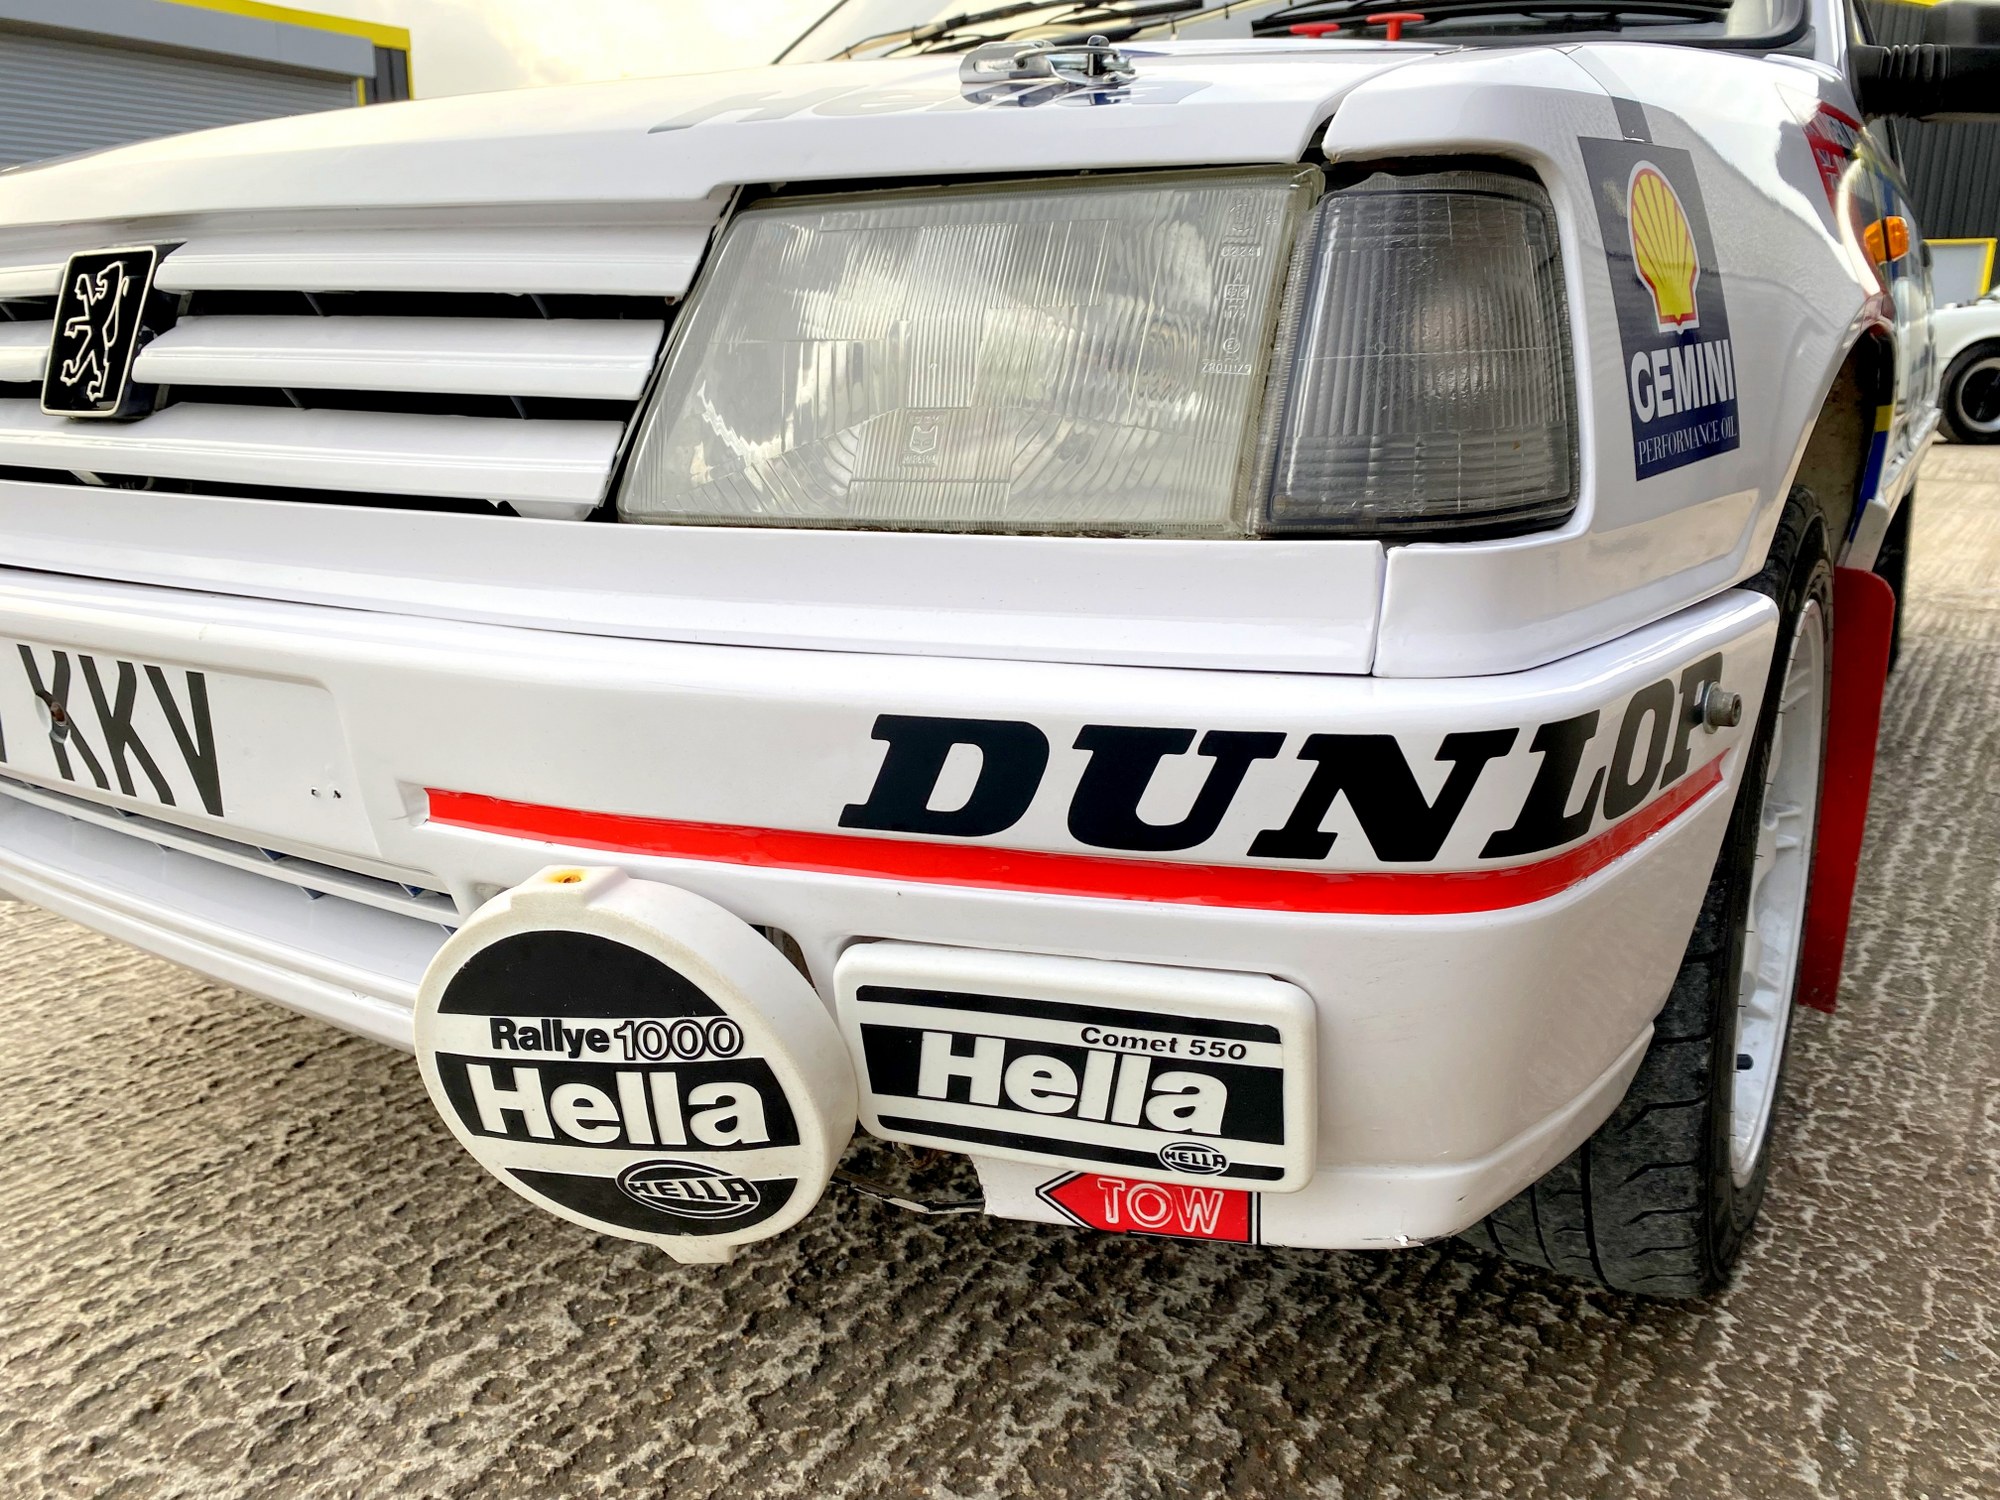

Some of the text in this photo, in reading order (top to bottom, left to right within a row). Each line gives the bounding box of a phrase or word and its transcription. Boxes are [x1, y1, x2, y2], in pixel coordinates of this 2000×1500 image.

[1631, 339, 1734, 423] GEMINI
[1638, 416, 1738, 465] PERFORMANCE OIL
[16, 644, 225, 817] KKV
[838, 652, 1723, 862] DUNLOP
[490, 1018, 744, 1061] Rallye 1000
[1080, 1026, 1247, 1061] Comet 550
[465, 1062, 771, 1147] Hella
[918, 1031, 1228, 1135] Hella
[1164, 1150, 1227, 1169] HELLA
[628, 1177, 757, 1203] HELLA
[1097, 1177, 1224, 1236] TOW
